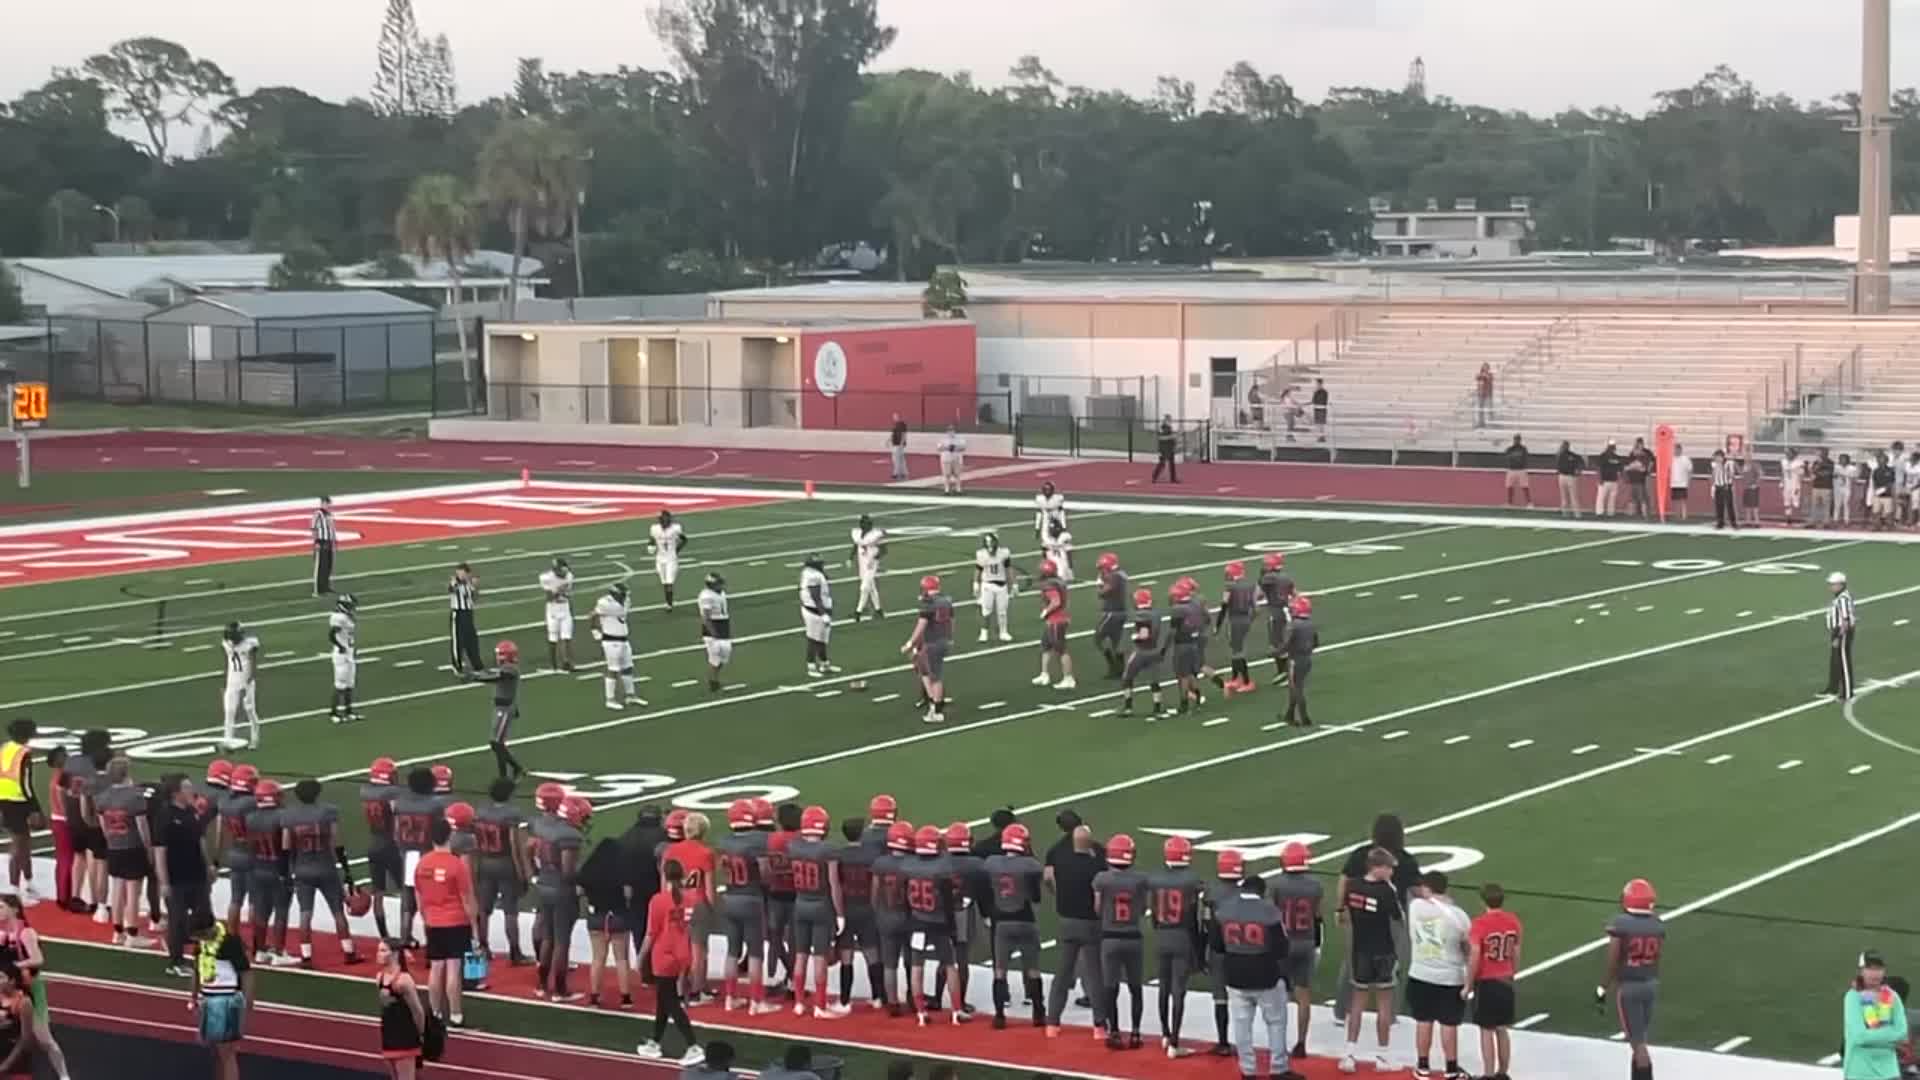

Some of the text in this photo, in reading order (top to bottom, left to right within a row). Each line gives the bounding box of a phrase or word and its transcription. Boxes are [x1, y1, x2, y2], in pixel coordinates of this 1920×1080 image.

[14, 384, 48, 419] 20
[1114, 892, 1131, 922] 6
[1157, 890, 1184, 925] 19
